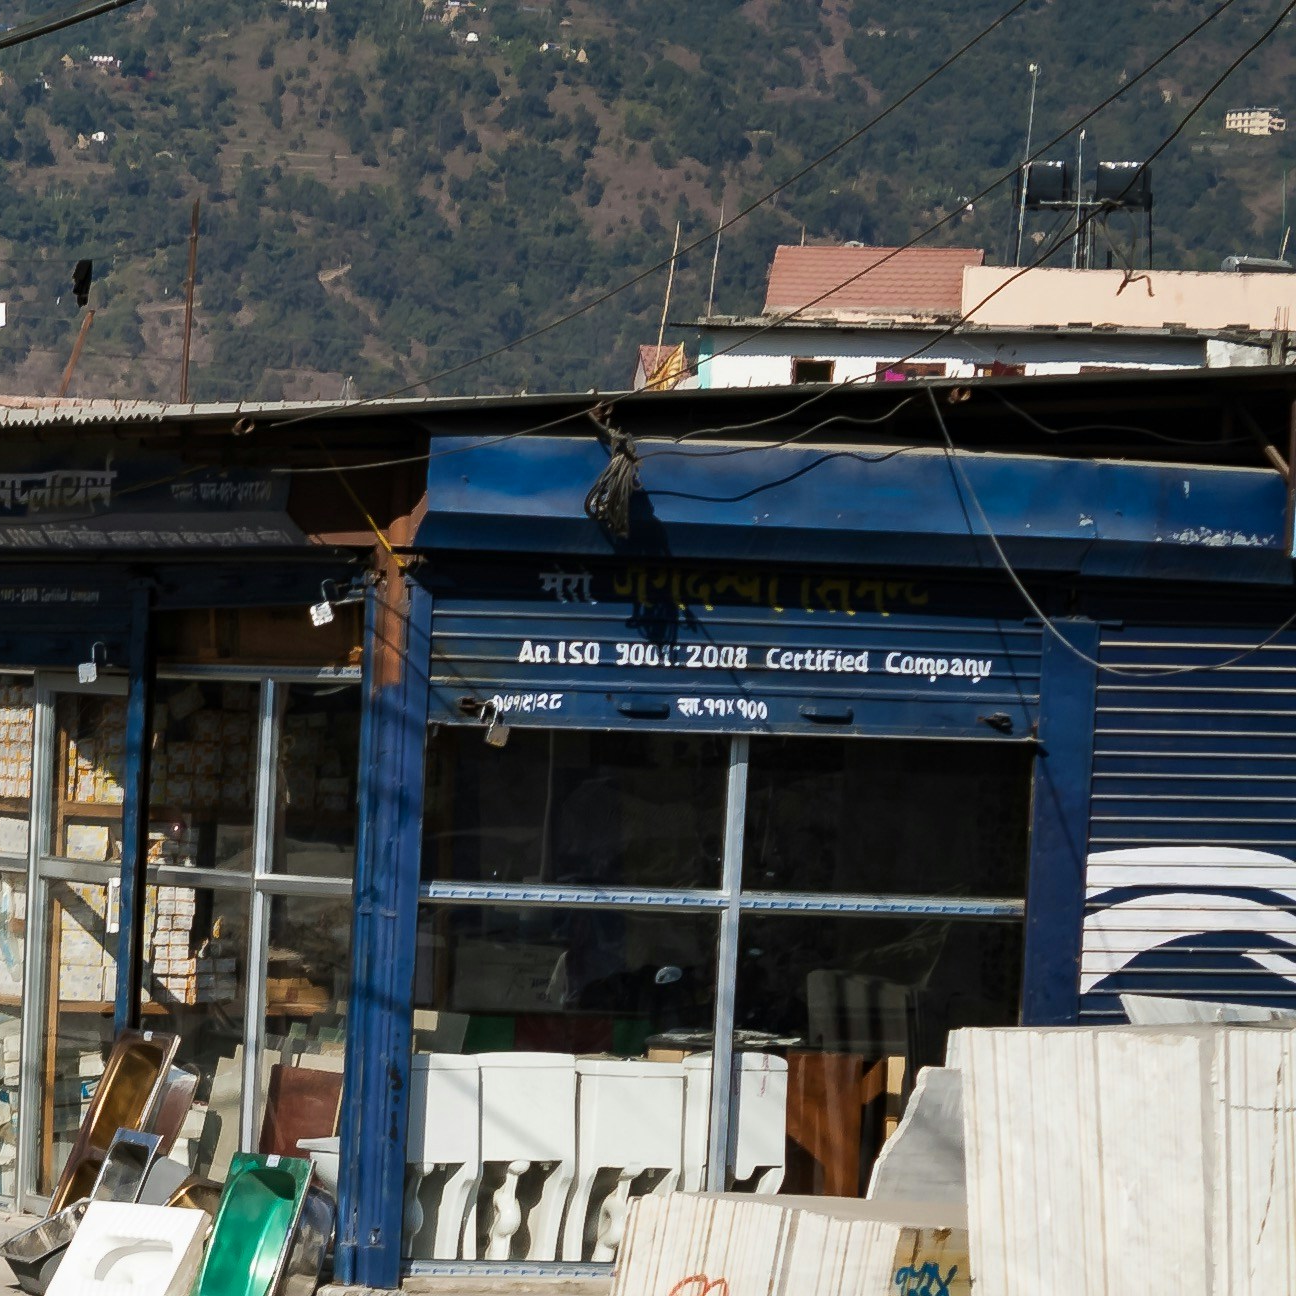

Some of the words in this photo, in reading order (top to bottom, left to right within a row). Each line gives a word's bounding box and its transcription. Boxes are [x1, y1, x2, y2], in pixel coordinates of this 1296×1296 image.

[518, 639, 557, 664] An
[765, 646, 870, 675] Certified
[884, 649, 993, 684] Company
